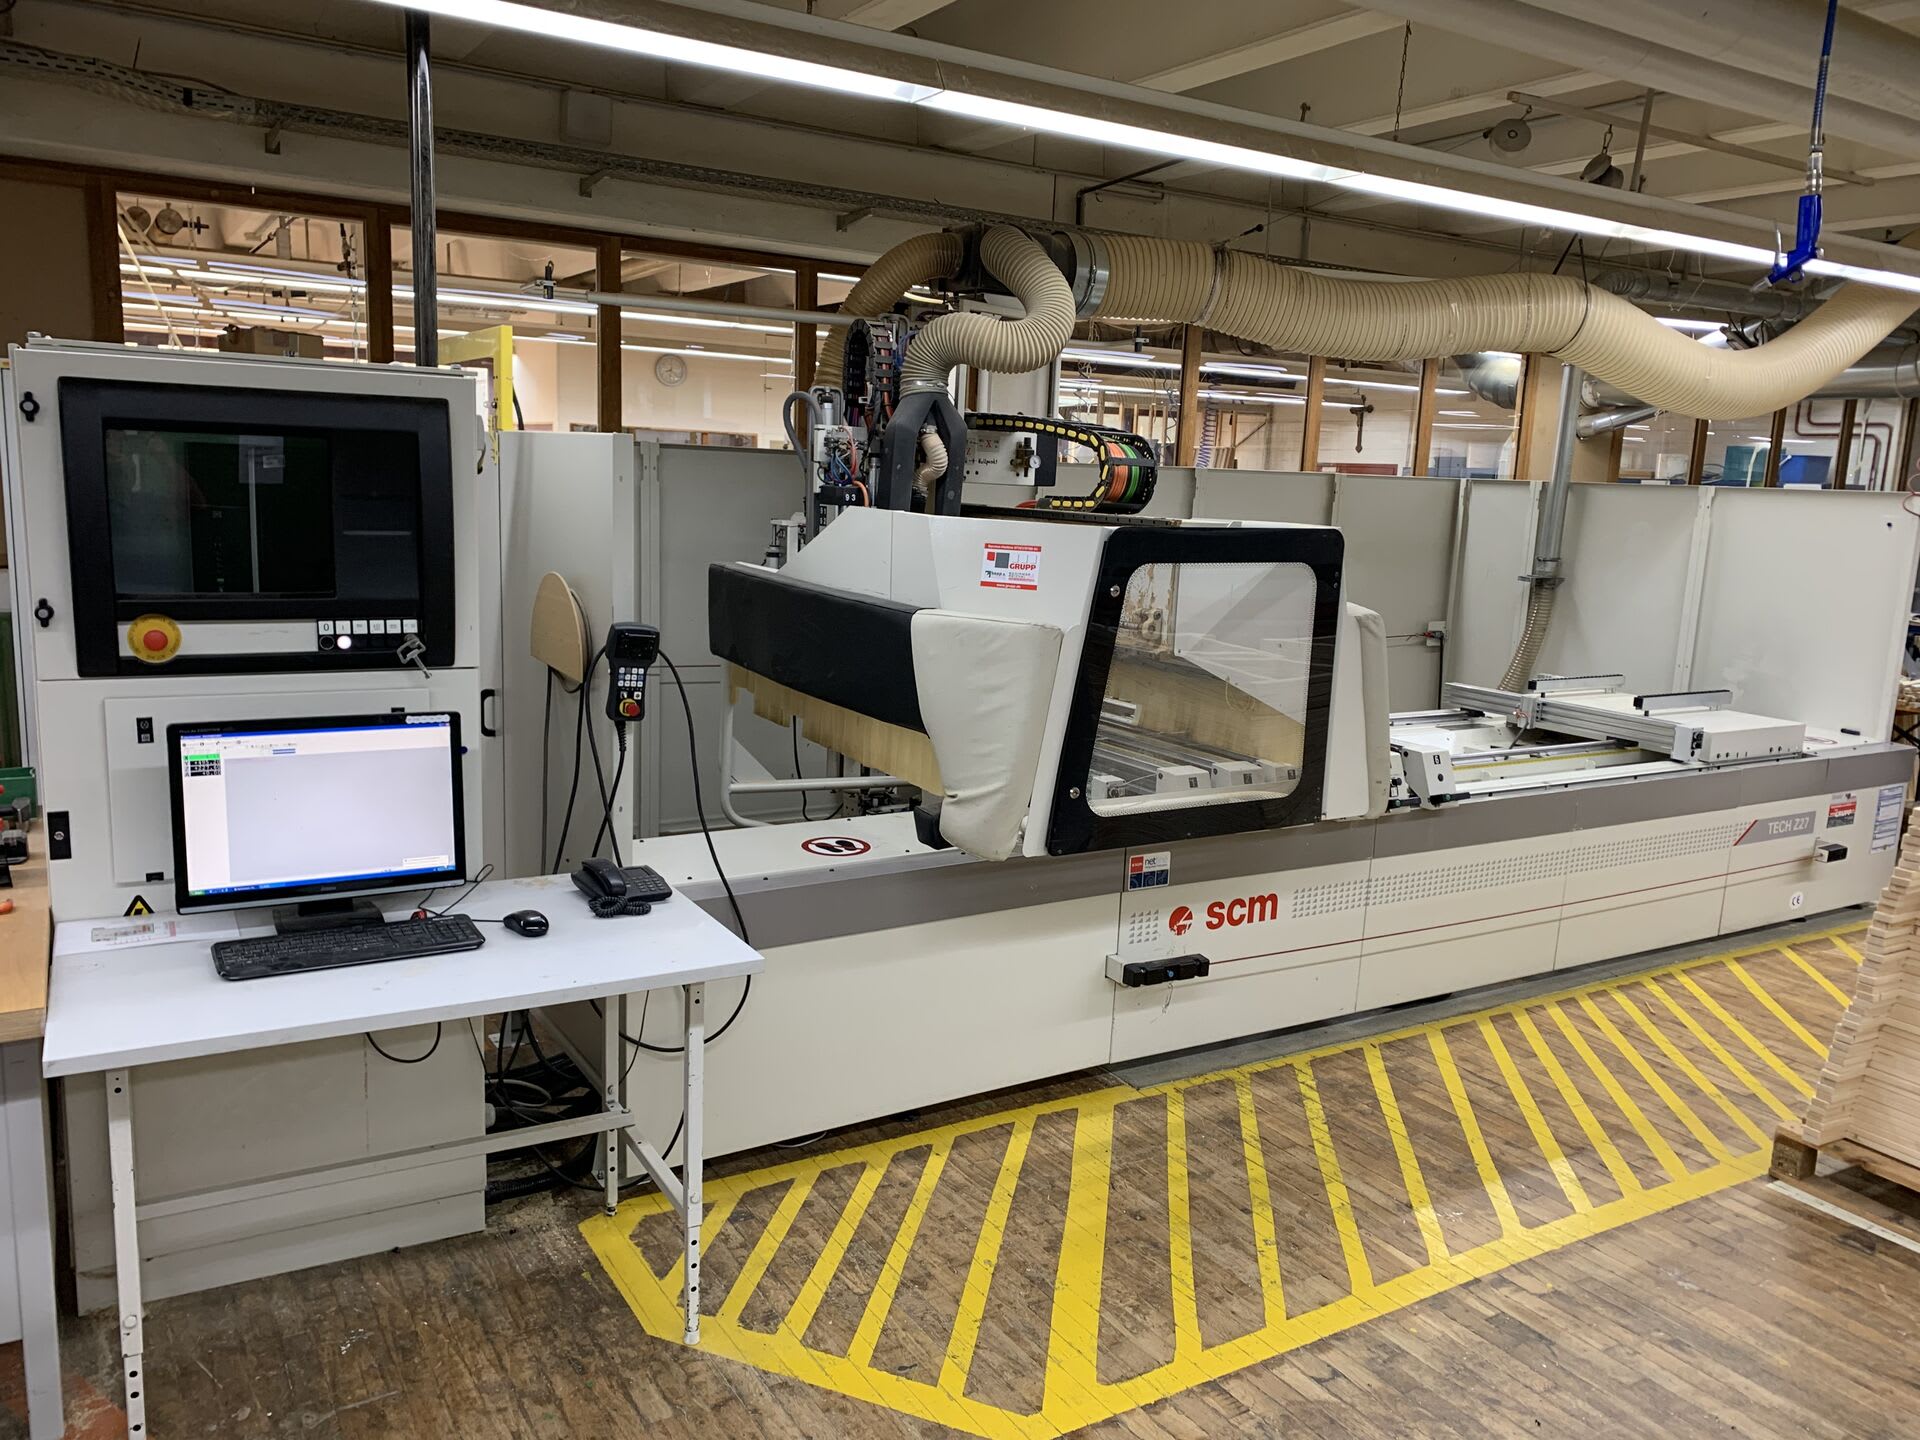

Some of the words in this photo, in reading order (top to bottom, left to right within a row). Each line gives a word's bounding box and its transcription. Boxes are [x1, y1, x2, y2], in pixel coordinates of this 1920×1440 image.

[1009, 563, 1036, 571] GRUPP
[1768, 821, 1792, 835] TECH
[1793, 817, 1810, 831] Z27
[1205, 893, 1278, 930] scm
